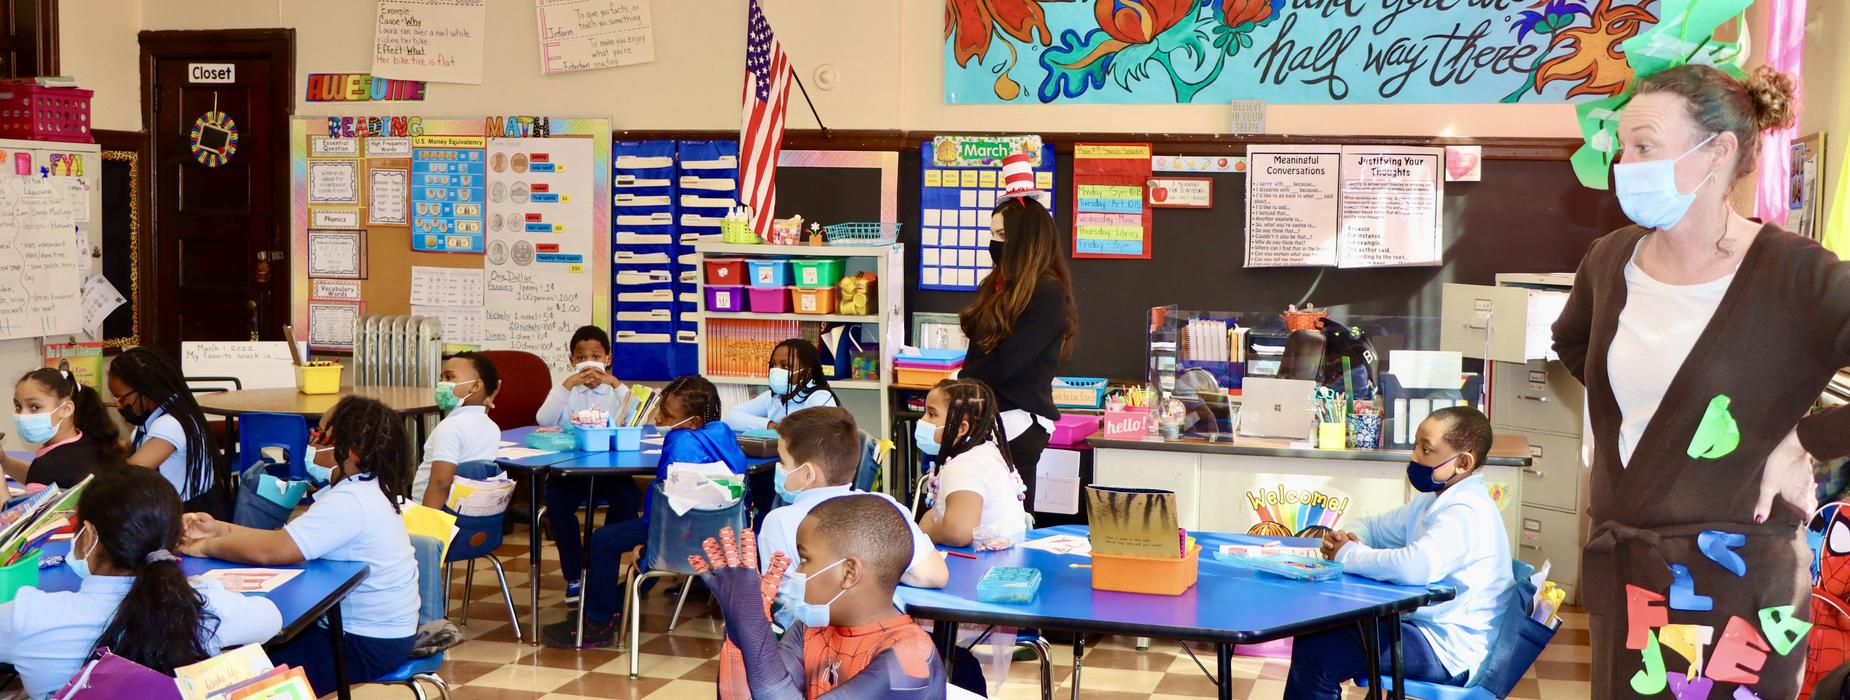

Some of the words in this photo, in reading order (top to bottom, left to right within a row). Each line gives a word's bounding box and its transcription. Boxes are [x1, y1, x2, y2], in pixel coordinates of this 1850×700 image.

[377, 54, 391, 64] Her
[394, 55, 409, 65] bike
[412, 56, 426, 65] tire
[437, 55, 455, 67] flat
[1254, 12, 1361, 100] half
[1363, 38, 1428, 98] way
[1423, 18, 1539, 87] there
[192, 66, 231, 80] Closet
[1233, 101, 1264, 111] BELIEVE
[328, 116, 424, 138] READING
[485, 116, 550, 138] MATH
[1235, 122, 1260, 132] SELFIE
[448, 139, 483, 147] Equivalency
[964, 143, 1008, 157] March
[1273, 156, 1319, 165] Meaningful
[1358, 157, 1402, 167] Justifying
[1404, 157, 1424, 166] Your
[1266, 166, 1325, 176] Conversations
[1371, 167, 1411, 178] Thoughts
[1078, 186, 1102, 198] Monday
[1079, 199, 1106, 210] Tuesday
[490, 270, 507, 281] One
[508, 270, 533, 281] Dollar
[321, 285, 354, 293] Vocabulary
[186, 351, 199, 362] My
[1106, 415, 1147, 435] hello!
[1246, 484, 1349, 516] Welcome!
